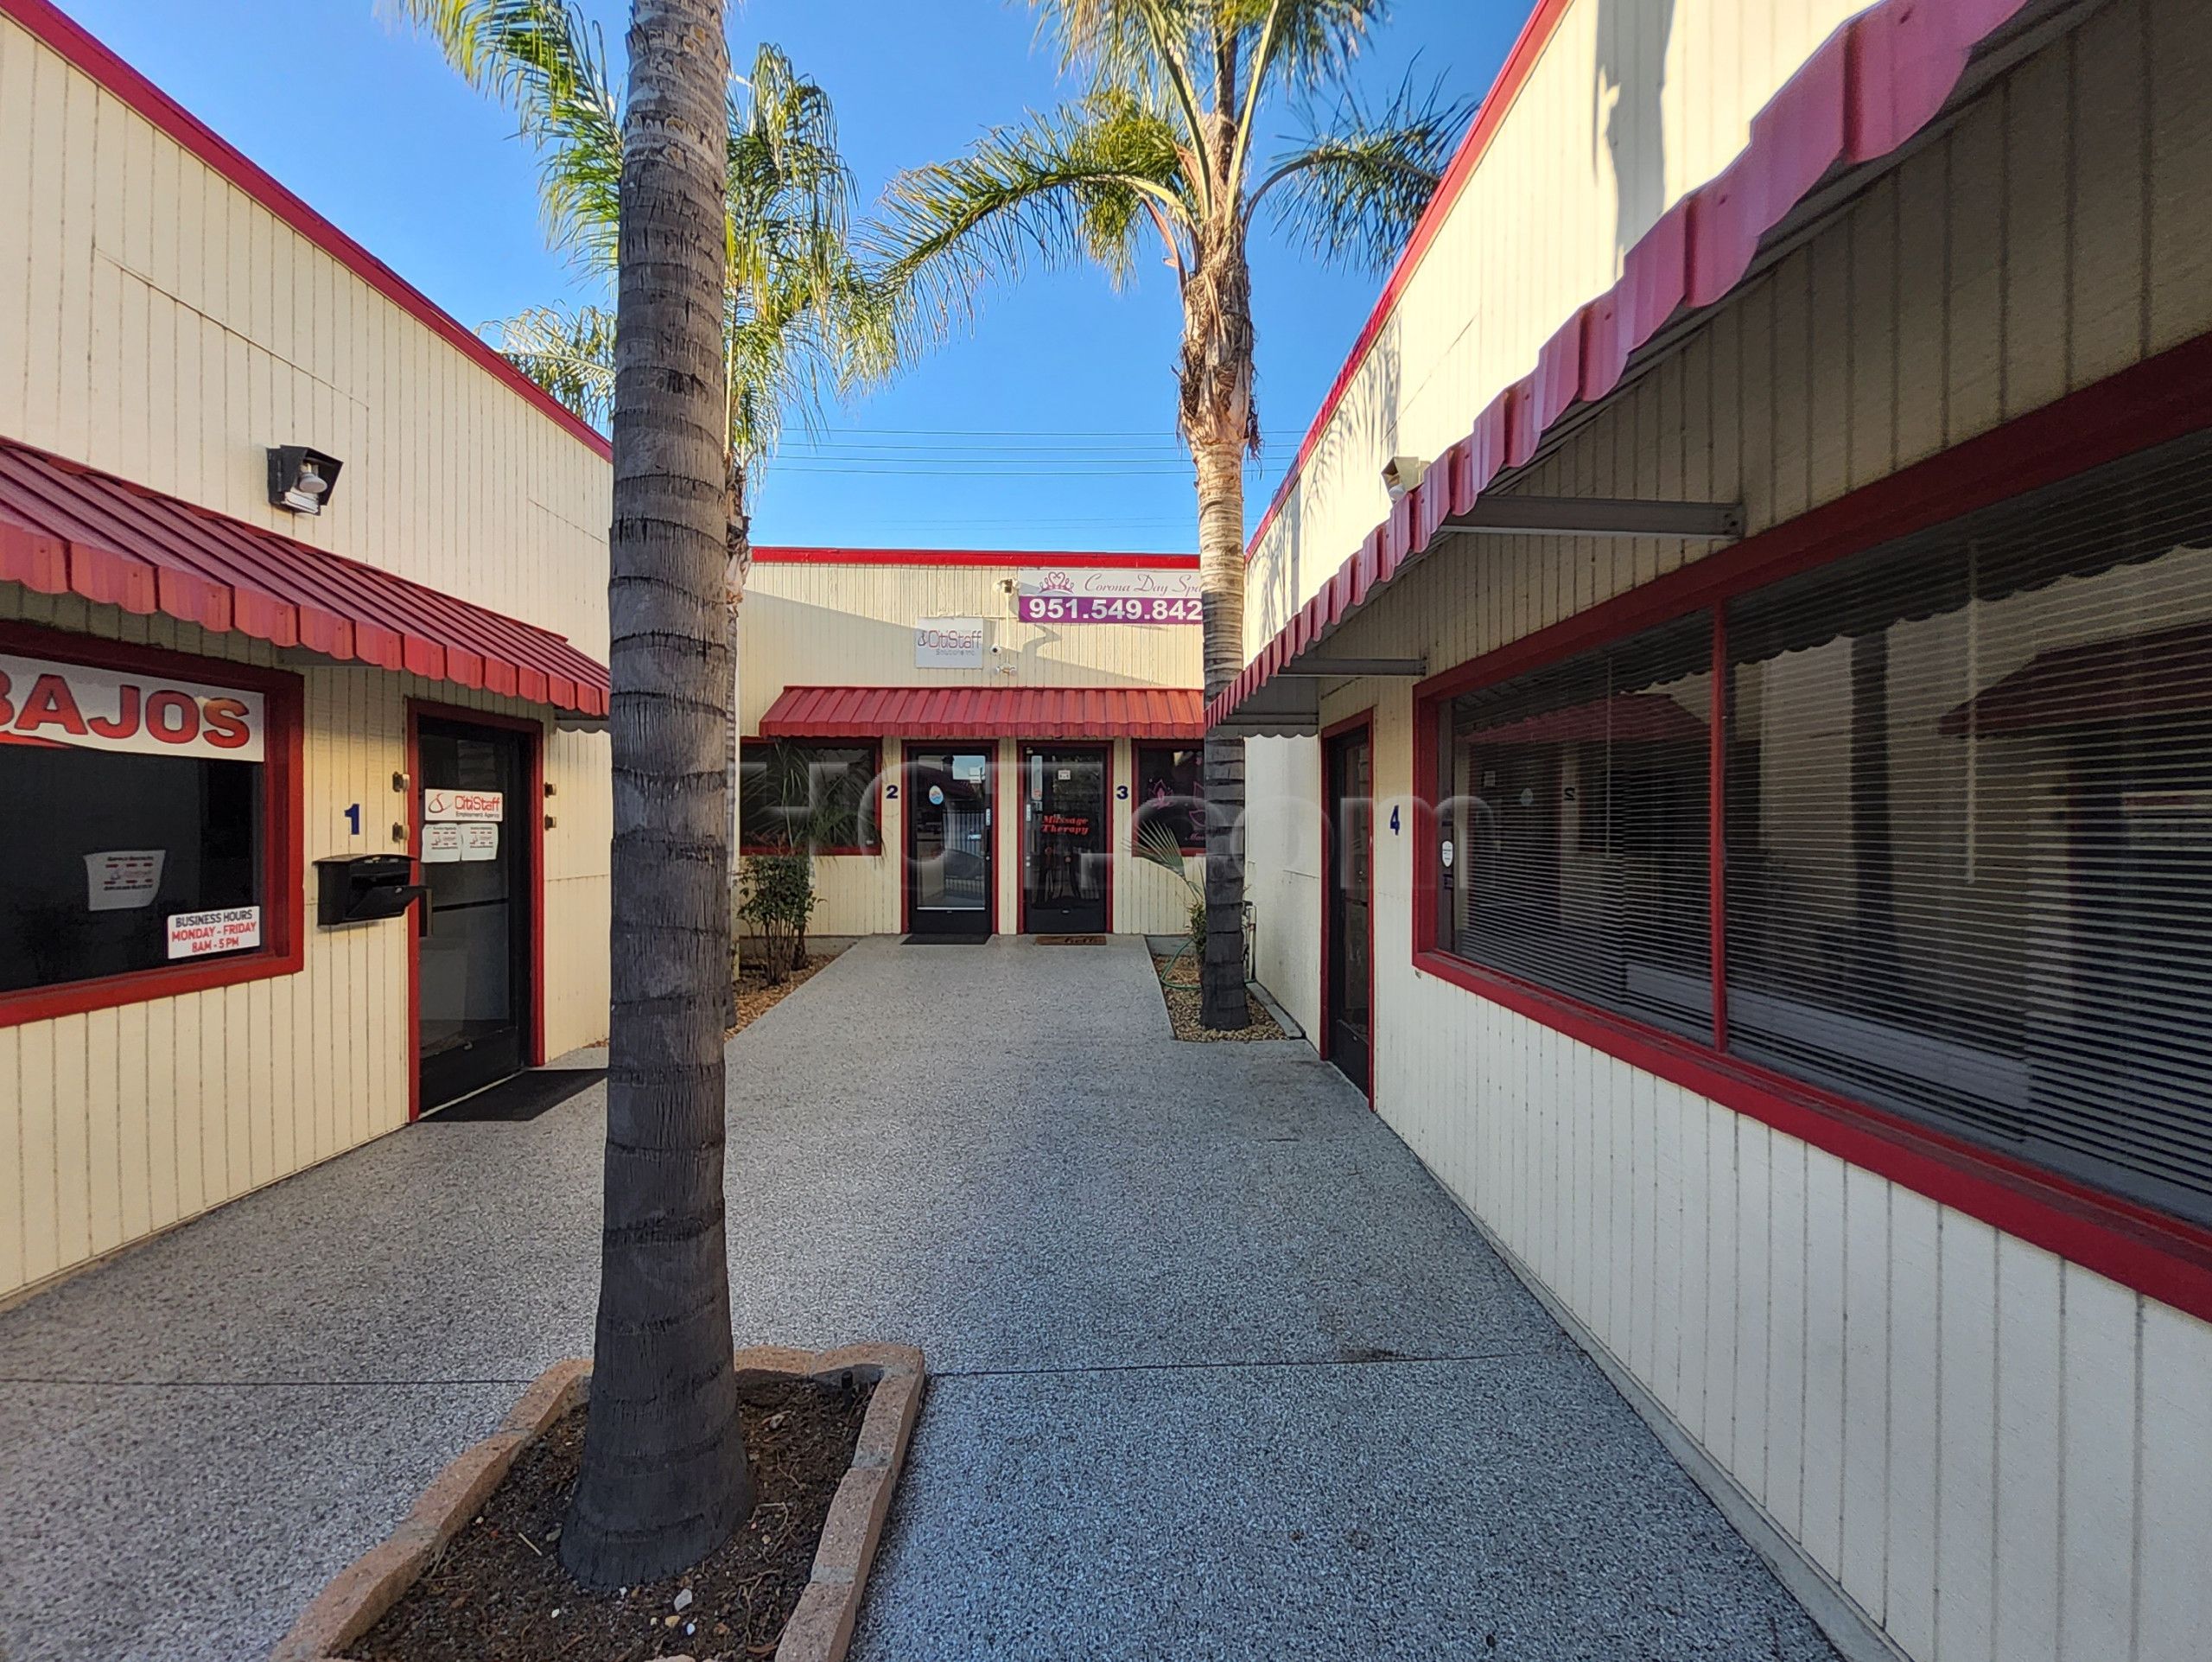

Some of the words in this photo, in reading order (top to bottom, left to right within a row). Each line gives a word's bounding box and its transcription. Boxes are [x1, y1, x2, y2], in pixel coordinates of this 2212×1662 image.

[1084, 574, 1130, 592] Corona
[1134, 574, 1167, 595] Day
[1029, 598, 1202, 621] 951.549.842
[928, 629, 982, 648] CitiStaff
[0, 670, 250, 748] AJOS
[886, 785, 899, 799] 2
[1116, 785, 1128, 799] 3
[454, 795, 499, 811] CitiStaff
[344, 803, 359, 835] 1
[1042, 815, 1089, 825] Massage
[1389, 805, 1400, 836] 4
[1041, 825, 1089, 836] Therapy
[175, 913, 221, 927] BUSINESS
[223, 910, 252, 922] HOURS
[172, 927, 215, 941] MONDAY
[223, 922, 256, 934] FRIDAY
[192, 939, 211, 952] 8AM
